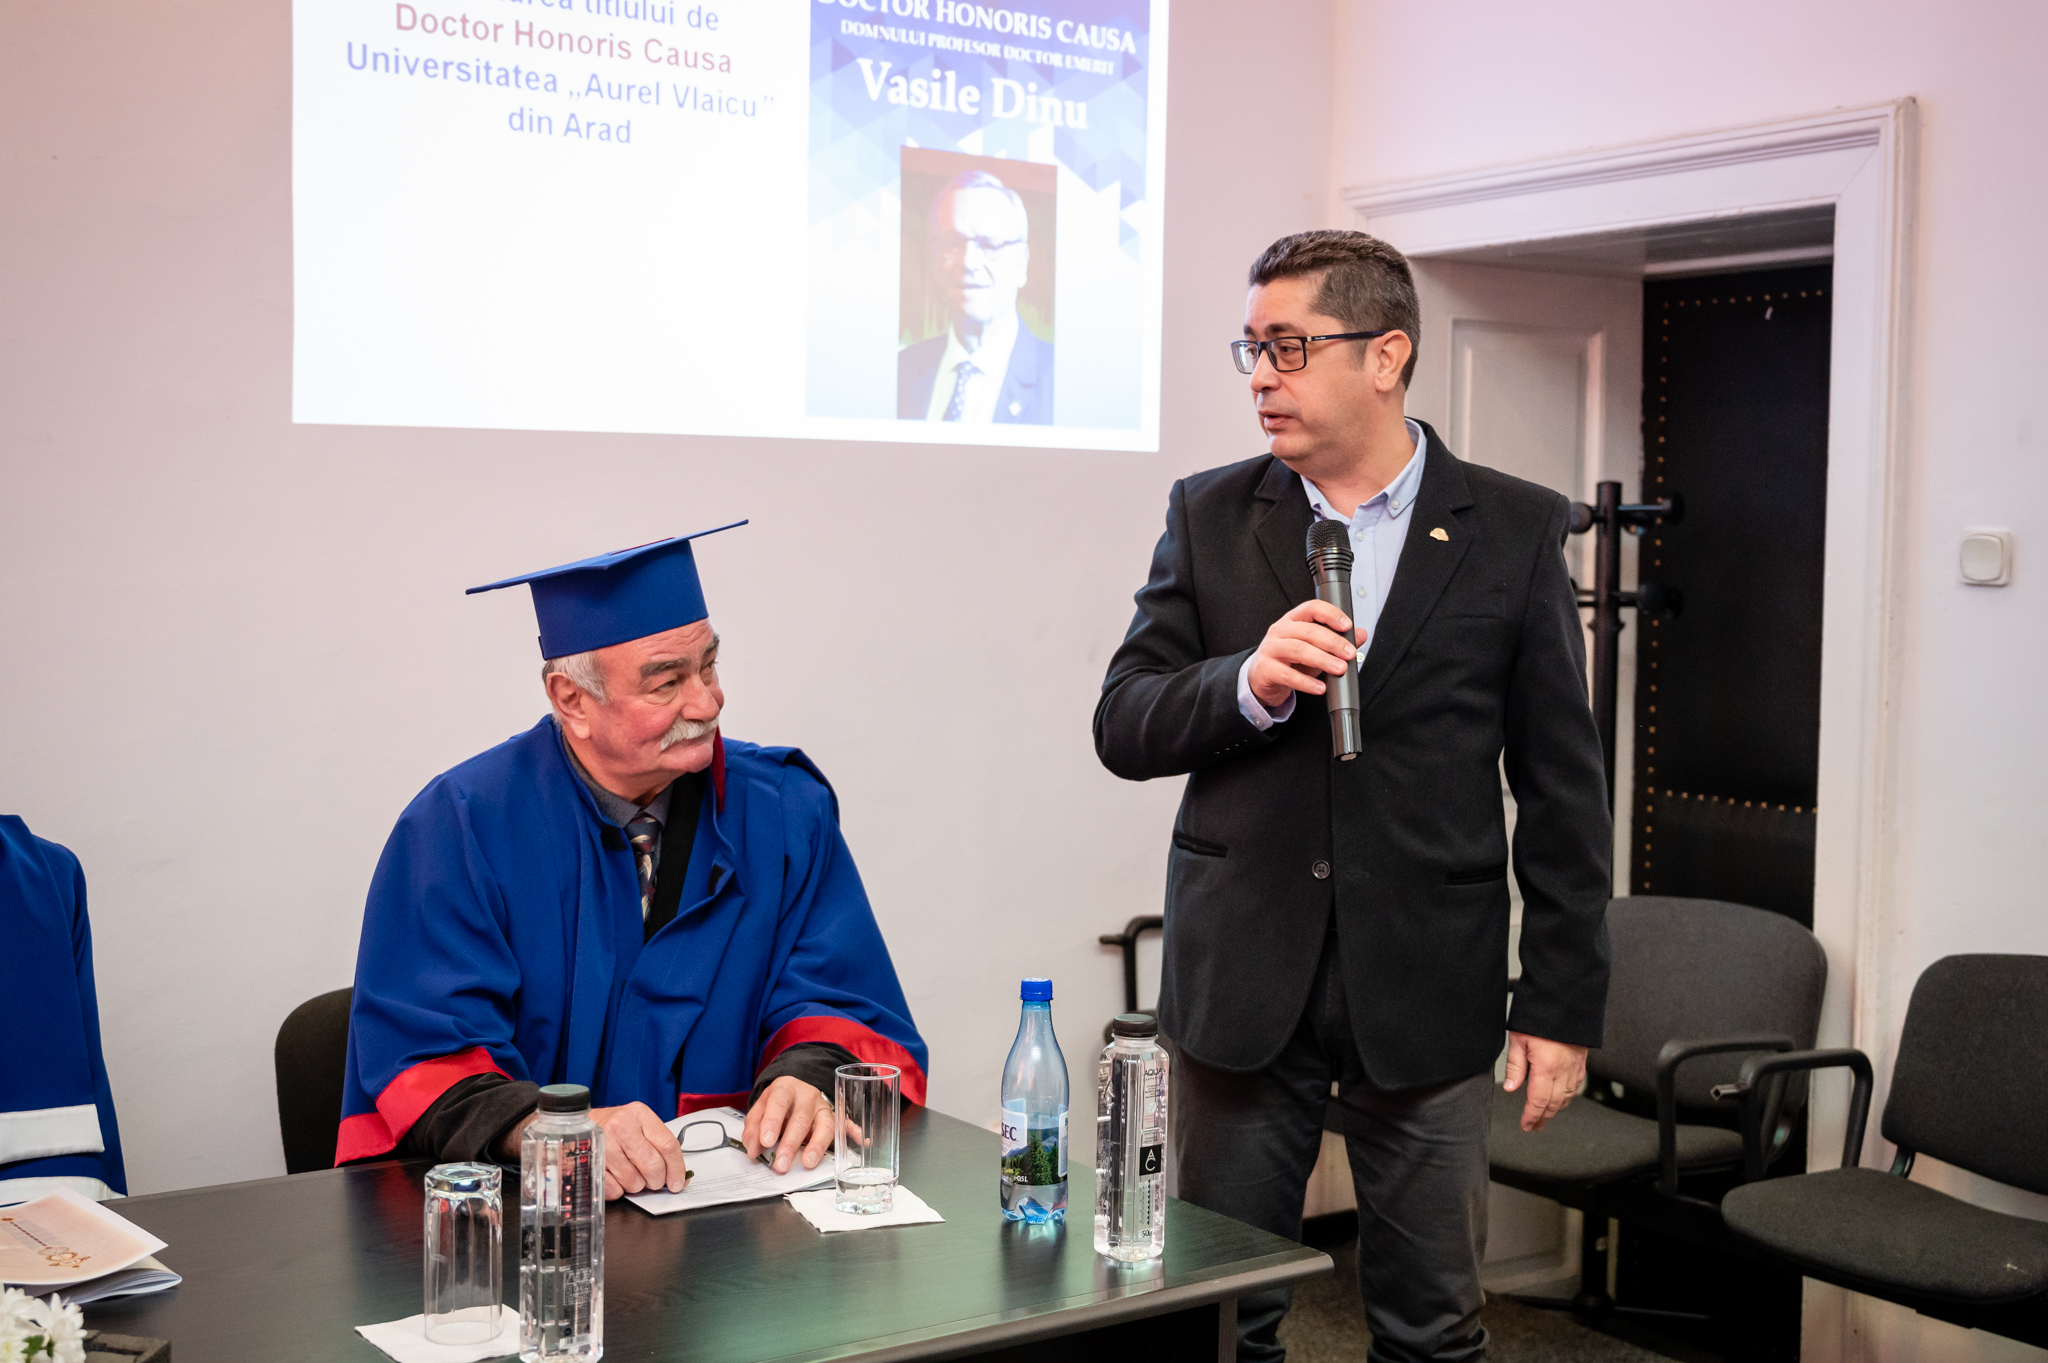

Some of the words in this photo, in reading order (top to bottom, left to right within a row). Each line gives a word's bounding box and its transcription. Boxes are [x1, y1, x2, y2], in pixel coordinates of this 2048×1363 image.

[396, 2, 504, 43] Doctor
[515, 19, 632, 60] Honoris
[643, 38, 732, 74] Causa
[687, 5, 719, 31] de
[936, 2, 1052, 40] HONORIS
[1056, 20, 1137, 54] CAUSA
[346, 41, 558, 94] Universitatea
[841, 19, 926, 47] DOMNULUI
[928, 32, 1001, 58] PROFESOR
[1003, 43, 1064, 68] DOCTOR
[1065, 53, 1116, 76] EMERIT
[857, 57, 981, 116] Vasile
[991, 76, 1089, 130] Dinu
[508, 107, 553, 136] din
[563, 112, 632, 144] Arad
